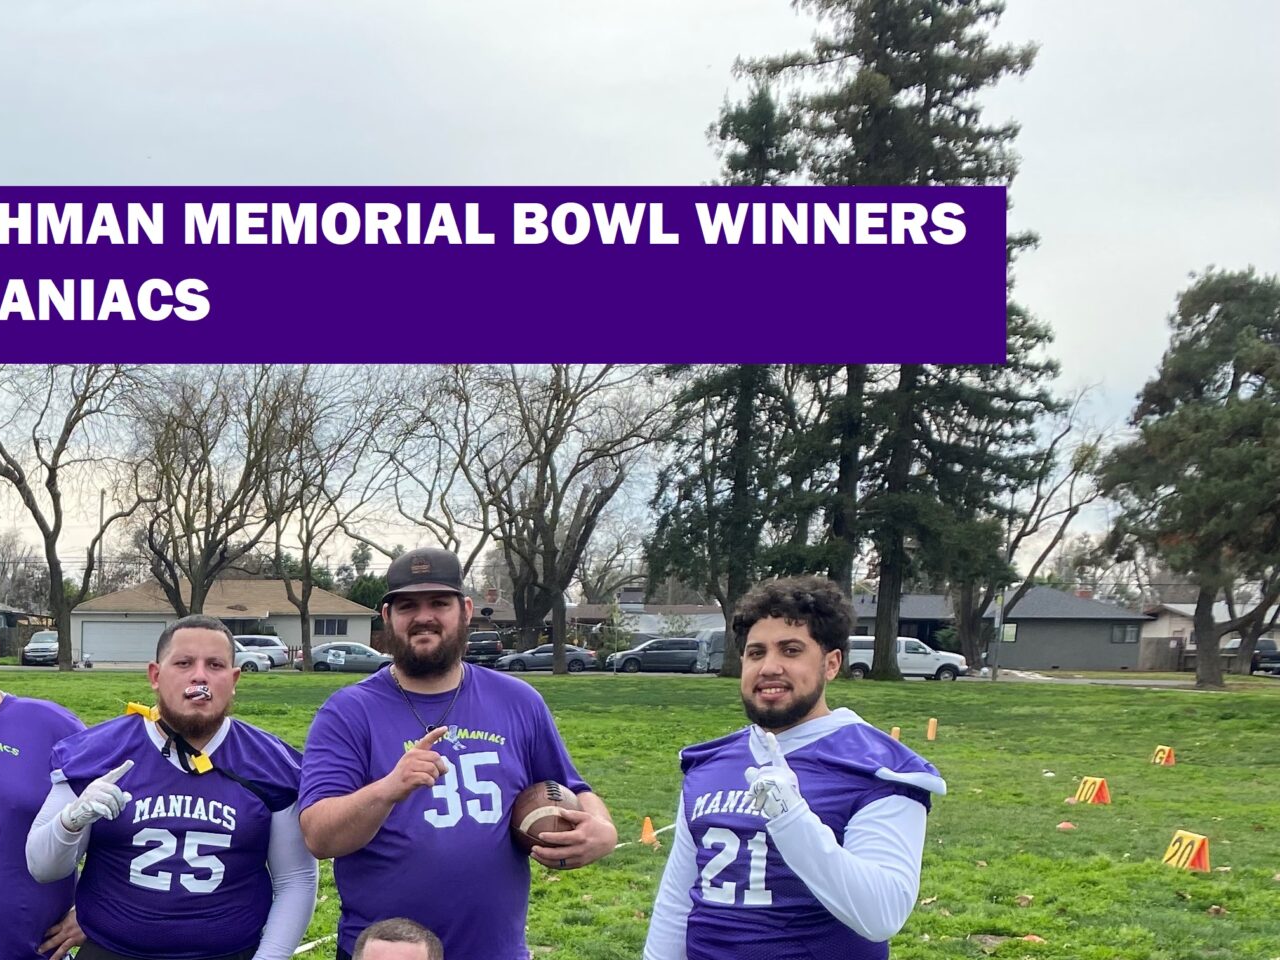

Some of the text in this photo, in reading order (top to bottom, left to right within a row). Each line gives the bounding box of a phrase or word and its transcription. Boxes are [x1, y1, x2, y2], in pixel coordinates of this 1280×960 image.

[456, 728, 506, 746] MANIACS
[1077, 779, 1098, 802] 10
[132, 794, 237, 831] MANIACS
[129, 827, 233, 893] 25
[700, 826, 773, 905] 21
[1163, 836, 1196, 869] 20
